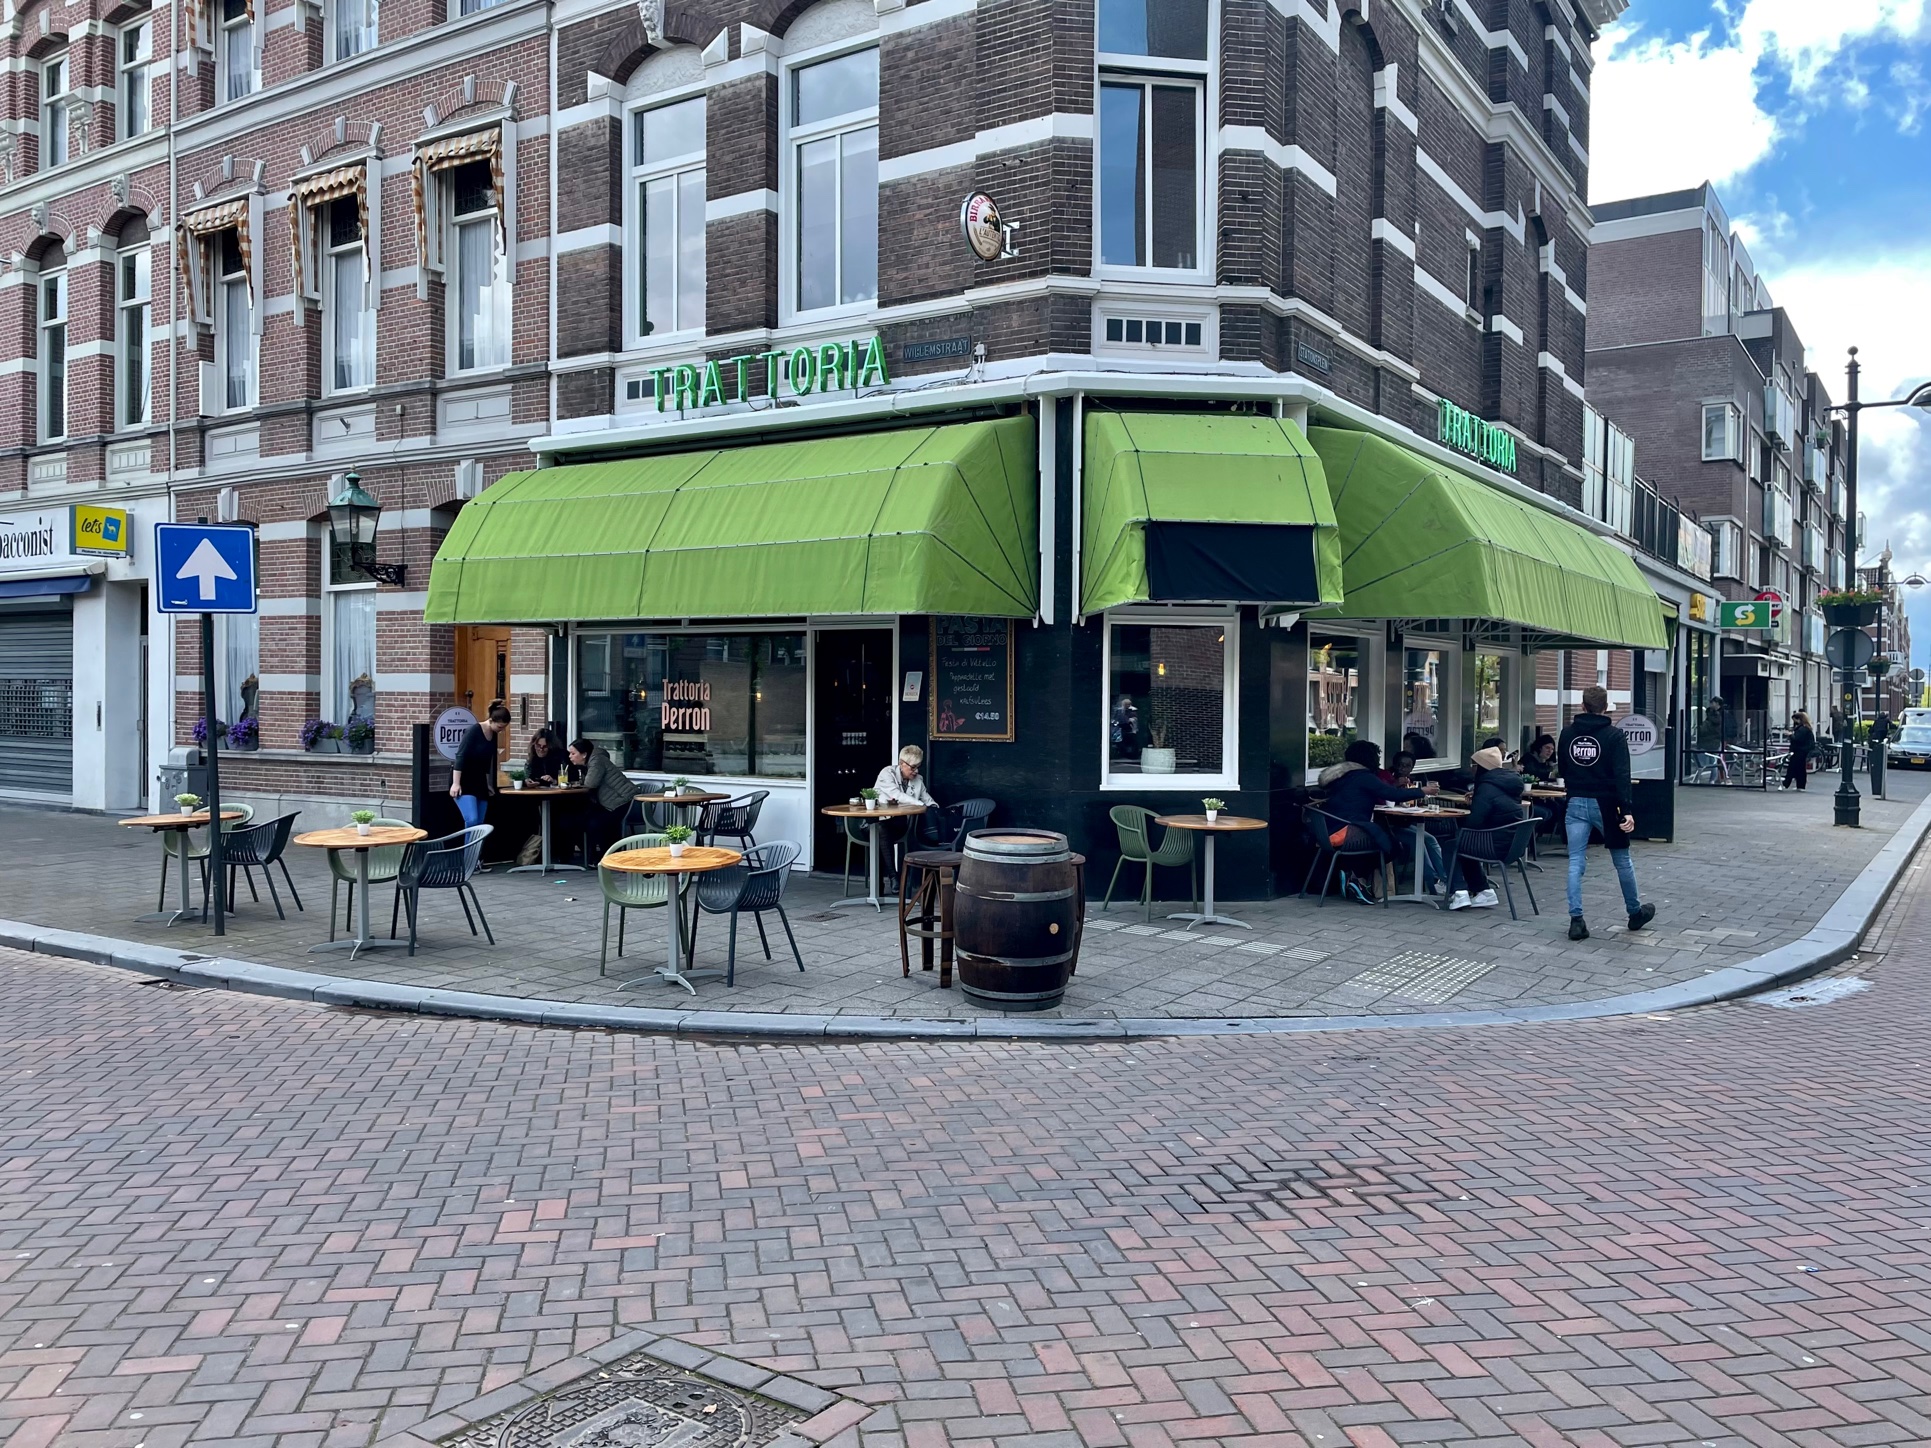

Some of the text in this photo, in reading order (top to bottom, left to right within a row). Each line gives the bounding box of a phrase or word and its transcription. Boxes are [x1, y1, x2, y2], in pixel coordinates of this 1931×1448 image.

[904, 339, 968, 359] WILLEMSTRAAT
[647, 335, 891, 413] TRATTORIA
[1440, 398, 1517, 473] TRATTORIA
[81, 517, 102, 534] let's
[936, 615, 1007, 634] PASTA
[936, 635, 959, 646] DEL
[662, 678, 711, 701] Trattoria
[661, 702, 711, 731] Perron
[440, 726, 467, 742] Perr
[1573, 745, 1596, 757] Perron
